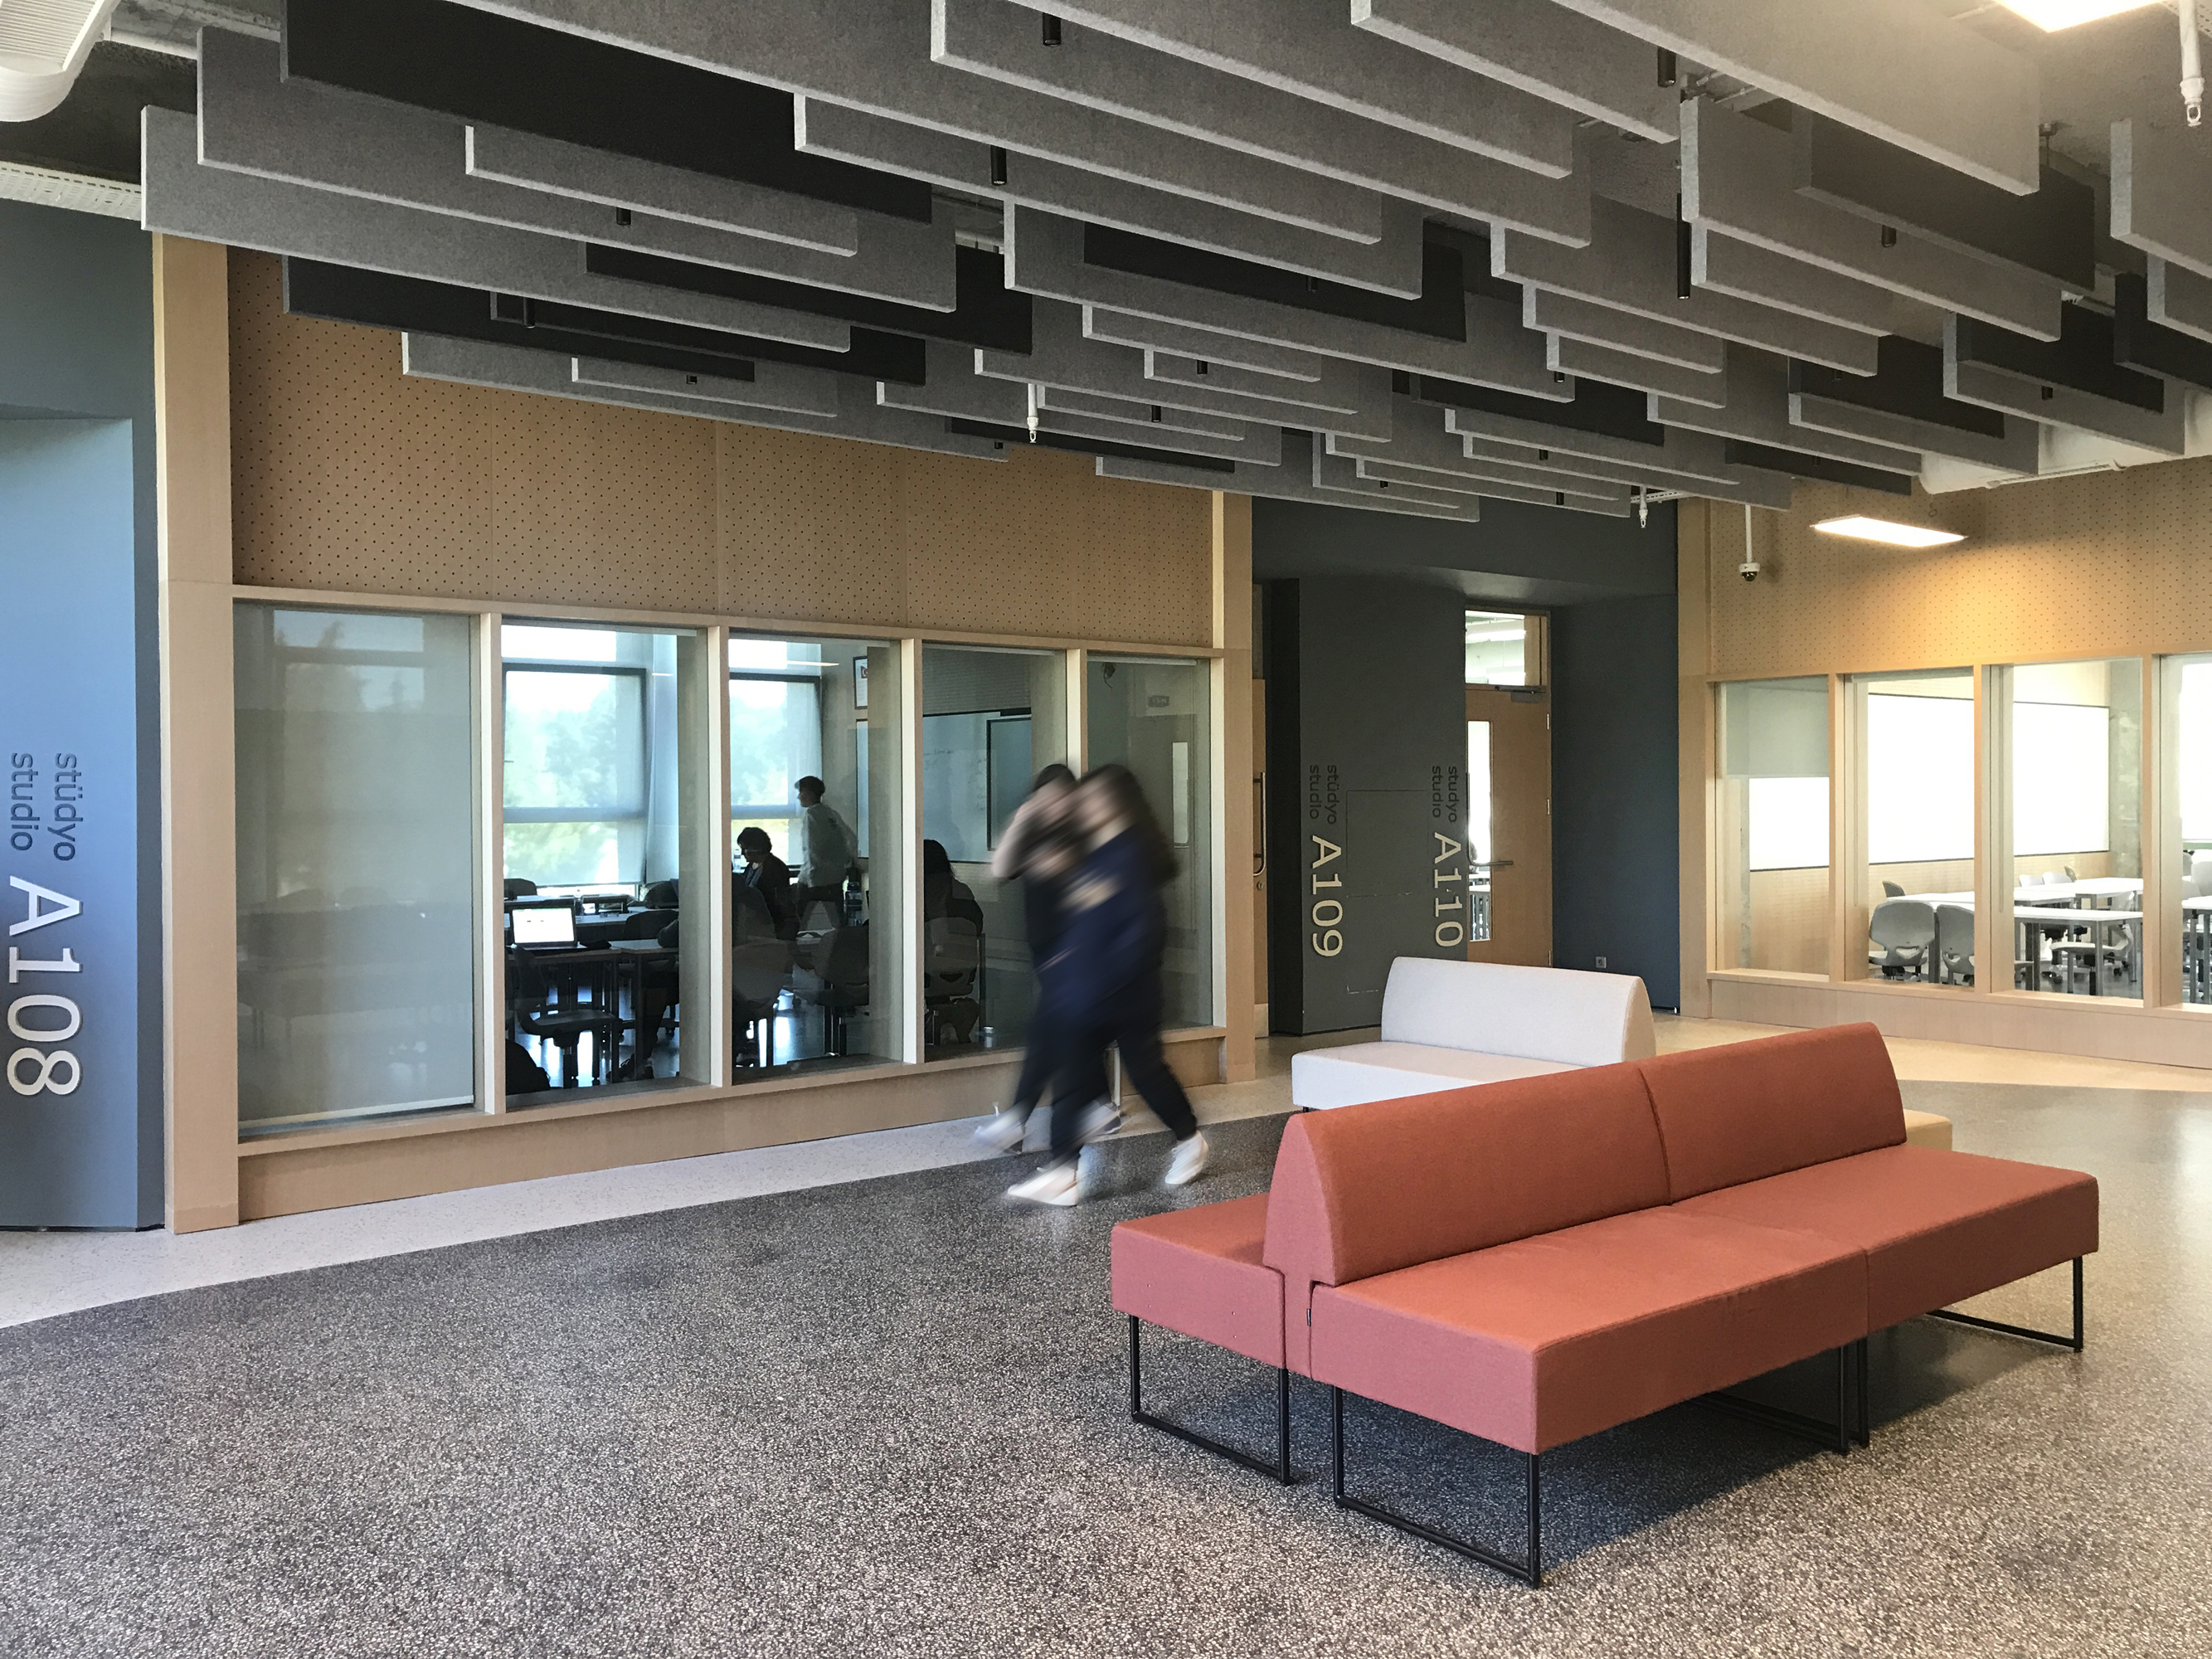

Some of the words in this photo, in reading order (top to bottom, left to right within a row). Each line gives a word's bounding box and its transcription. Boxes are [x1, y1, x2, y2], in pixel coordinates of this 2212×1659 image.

[11, 752, 40, 851] studio
[47, 752, 83, 861] stüdyo
[1310, 765, 1322, 820] studio
[1325, 765, 1339, 825] stüdyo
[1432, 766, 1444, 818] studio
[1312, 834, 1343, 956] A109
[1434, 832, 1464, 946] A110
[7, 875, 82, 1096] A108
